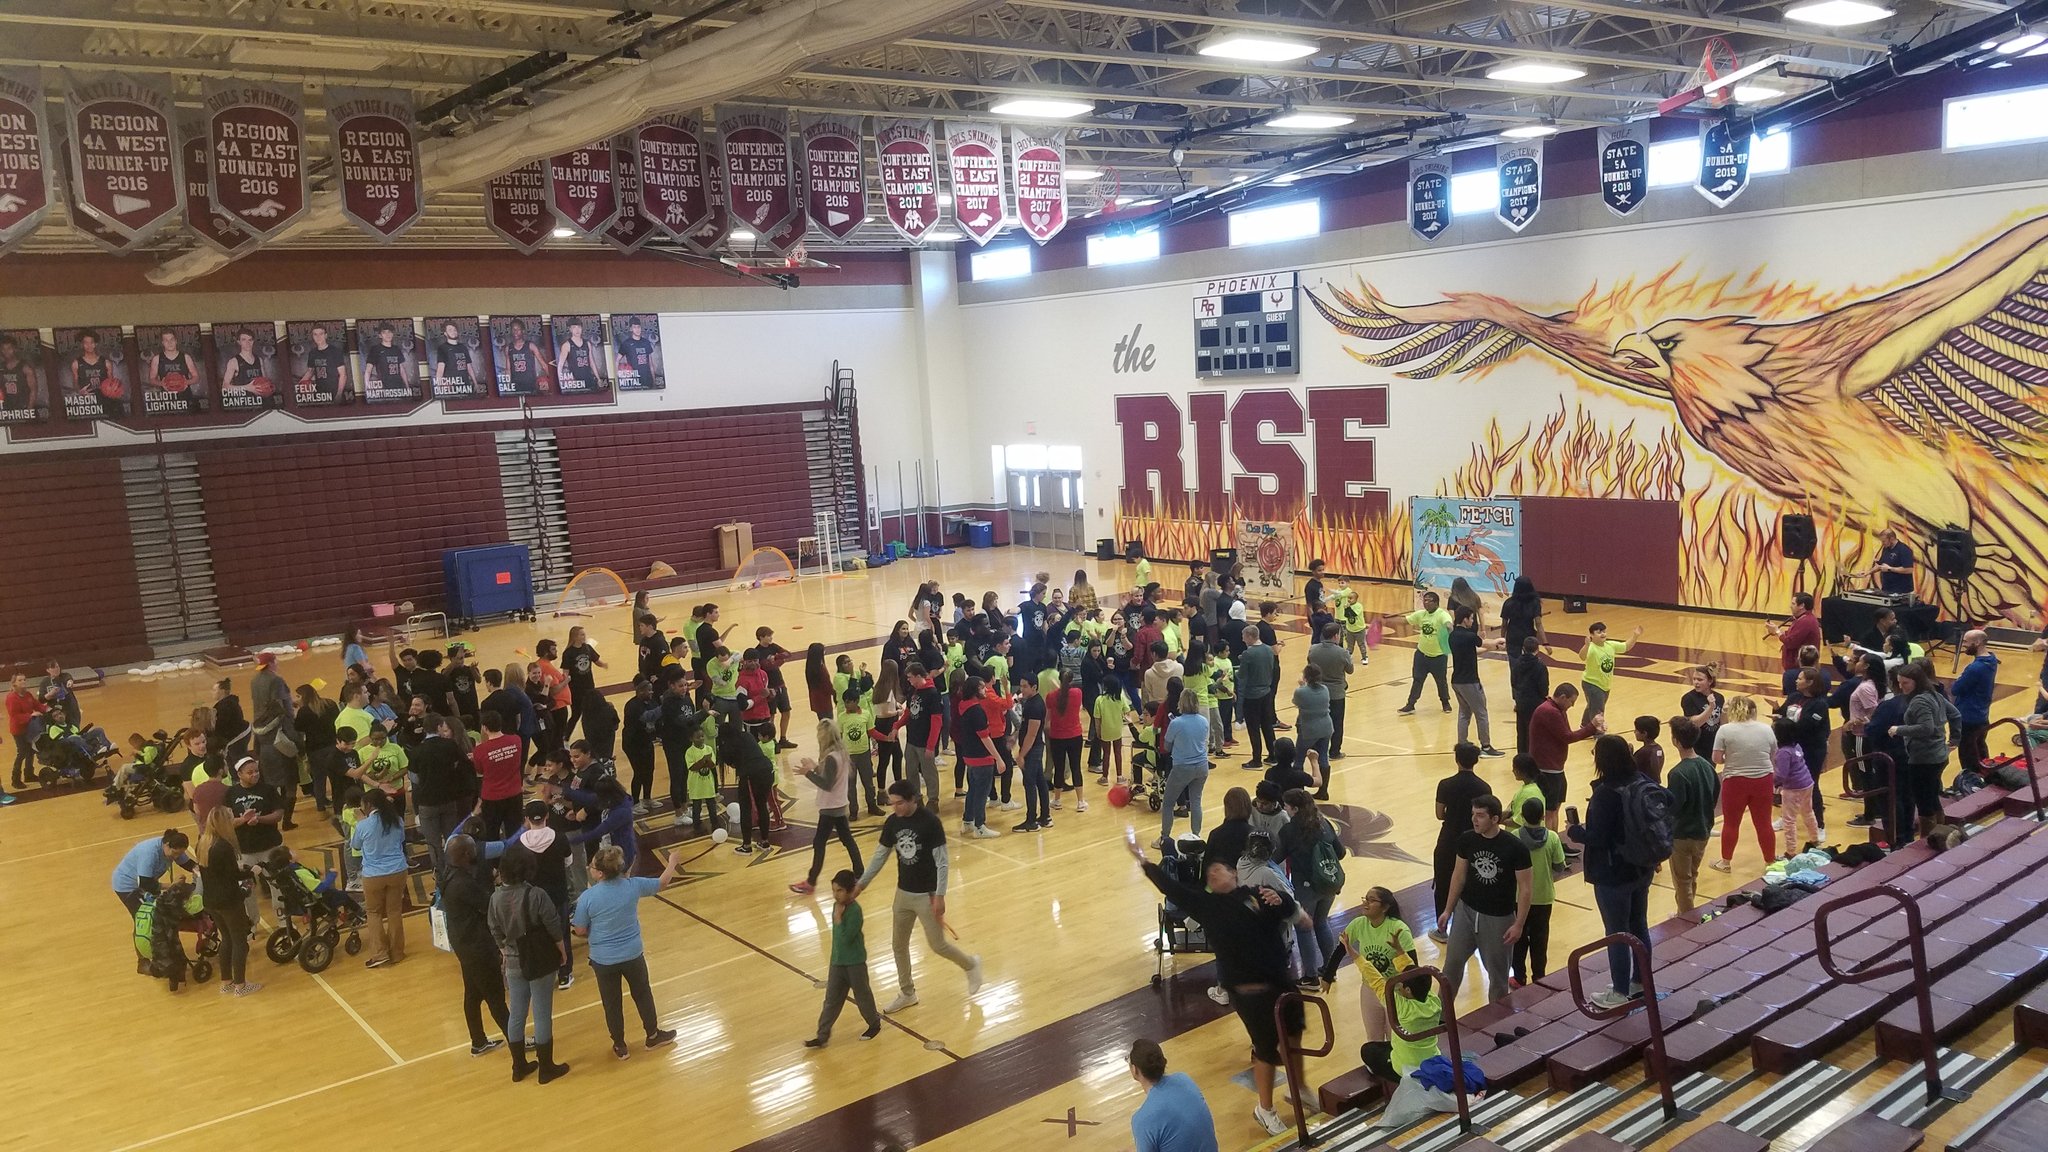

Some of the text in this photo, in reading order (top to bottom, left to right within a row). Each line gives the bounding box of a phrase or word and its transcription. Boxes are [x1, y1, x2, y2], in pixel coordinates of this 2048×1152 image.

[207, 88, 299, 116] GIRLS SWIMMING
[90, 114, 159, 131] REGION
[222, 122, 289, 141] REGION
[878, 125, 931, 146] WRESTLING
[1612, 129, 1632, 140] GOLF
[0, 134, 38, 150] EST
[83, 134, 167, 151] 4A WEST
[345, 131, 405, 147] REGION
[1016, 136, 1037, 152] BOYS
[216, 141, 241, 157] 4A
[251, 143, 298, 161] EAST
[640, 139, 698, 156] CONFERENCE
[726, 143, 786, 156] CONFERENCE
[1606, 146, 1637, 159] STATE
[342, 149, 412, 165] 3A EAST
[572, 152, 589, 166] 28
[808, 149, 859, 163] CONFERENCE
[881, 153, 931, 166] CONFERENCE
[953, 156, 998, 168] CONFERENCE
[1705, 153, 1748, 167] RUNNER-UP
[86, 154, 169, 172] RUNNER-UP
[219, 159, 297, 178] RUNNER-UP
[644, 156, 697, 172] 21 EAST
[730, 158, 784, 171] 21 EAST
[1019, 160, 1061, 172] CONFERENCE
[1505, 163, 1532, 176] STATE
[1614, 159, 1627, 169] 5A
[345, 165, 413, 182] RUNNER-UP
[552, 166, 611, 184] CHAMPIONS
[812, 165, 823, 177] 21
[828, 165, 858, 178] EAST
[885, 168, 930, 180] 21 EAST
[955, 169, 997, 183] 21 EAST
[1604, 168, 1642, 183] RUNNER-UP
[1714, 167, 1738, 178] 2019
[107, 176, 148, 191] 2016
[644, 171, 700, 187] CHAMPIONS
[730, 173, 786, 187] CHAMPIONS
[1020, 174, 1059, 186] 21 EAST
[1417, 179, 1442, 190] STATE
[1514, 176, 1524, 186] 4A
[240, 179, 278, 195] 2016
[366, 184, 400, 198] 2015
[568, 184, 598, 199] 2015
[811, 180, 861, 193] CHAMPIONS
[886, 182, 933, 195] CHAMPIONS
[956, 184, 999, 196] CHAMPIONS
[1020, 187, 1060, 199] CHAMPIONS
[1502, 184, 1537, 198] CHAMPIONS
[1612, 182, 1632, 192] 2018
[493, 187, 545, 200] CHAMPION
[660, 188, 688, 201] 2016
[746, 189, 773, 202] 2016
[1423, 191, 1433, 199] 4A
[825, 195, 849, 207] 2016
[899, 197, 923, 209] 2017
[966, 197, 989, 210] 2017
[1030, 201, 1051, 212] 2017
[1415, 201, 1446, 211] RUNNER-UP
[1510, 197, 1528, 207] 2017
[510, 203, 539, 215] 2018
[1422, 211, 1437, 220] 2017
[1207, 275, 1277, 295] PHOENIX
[1201, 319, 1217, 327] HOME
[1266, 312, 1287, 322] GUEST
[1112, 323, 1157, 374] the
[433, 376, 465, 386] MICHAEL
[498, 375, 510, 383] TED
[559, 372, 574, 380] SAM
[619, 378, 641, 386] MITTAL
[294, 385, 318, 393] FELIX
[366, 380, 382, 389] NICO
[434, 385, 473, 395] DUELLMAN
[499, 383, 516, 391] GALE
[560, 380, 586, 389] LARSEN
[144, 391, 179, 401] ELLIOTT
[221, 388, 247, 397] CHRIS
[295, 392, 333, 403] CARLSON
[366, 388, 413, 398] MARTIROSSIAN
[65, 395, 98, 406] MASON
[146, 400, 188, 412] LIGHTNER
[223, 396, 263, 406] CANFIELD
[66, 405, 104, 416] HUDSON
[1114, 384, 1390, 532] RISE
[1459, 504, 1514, 526] FETCH
